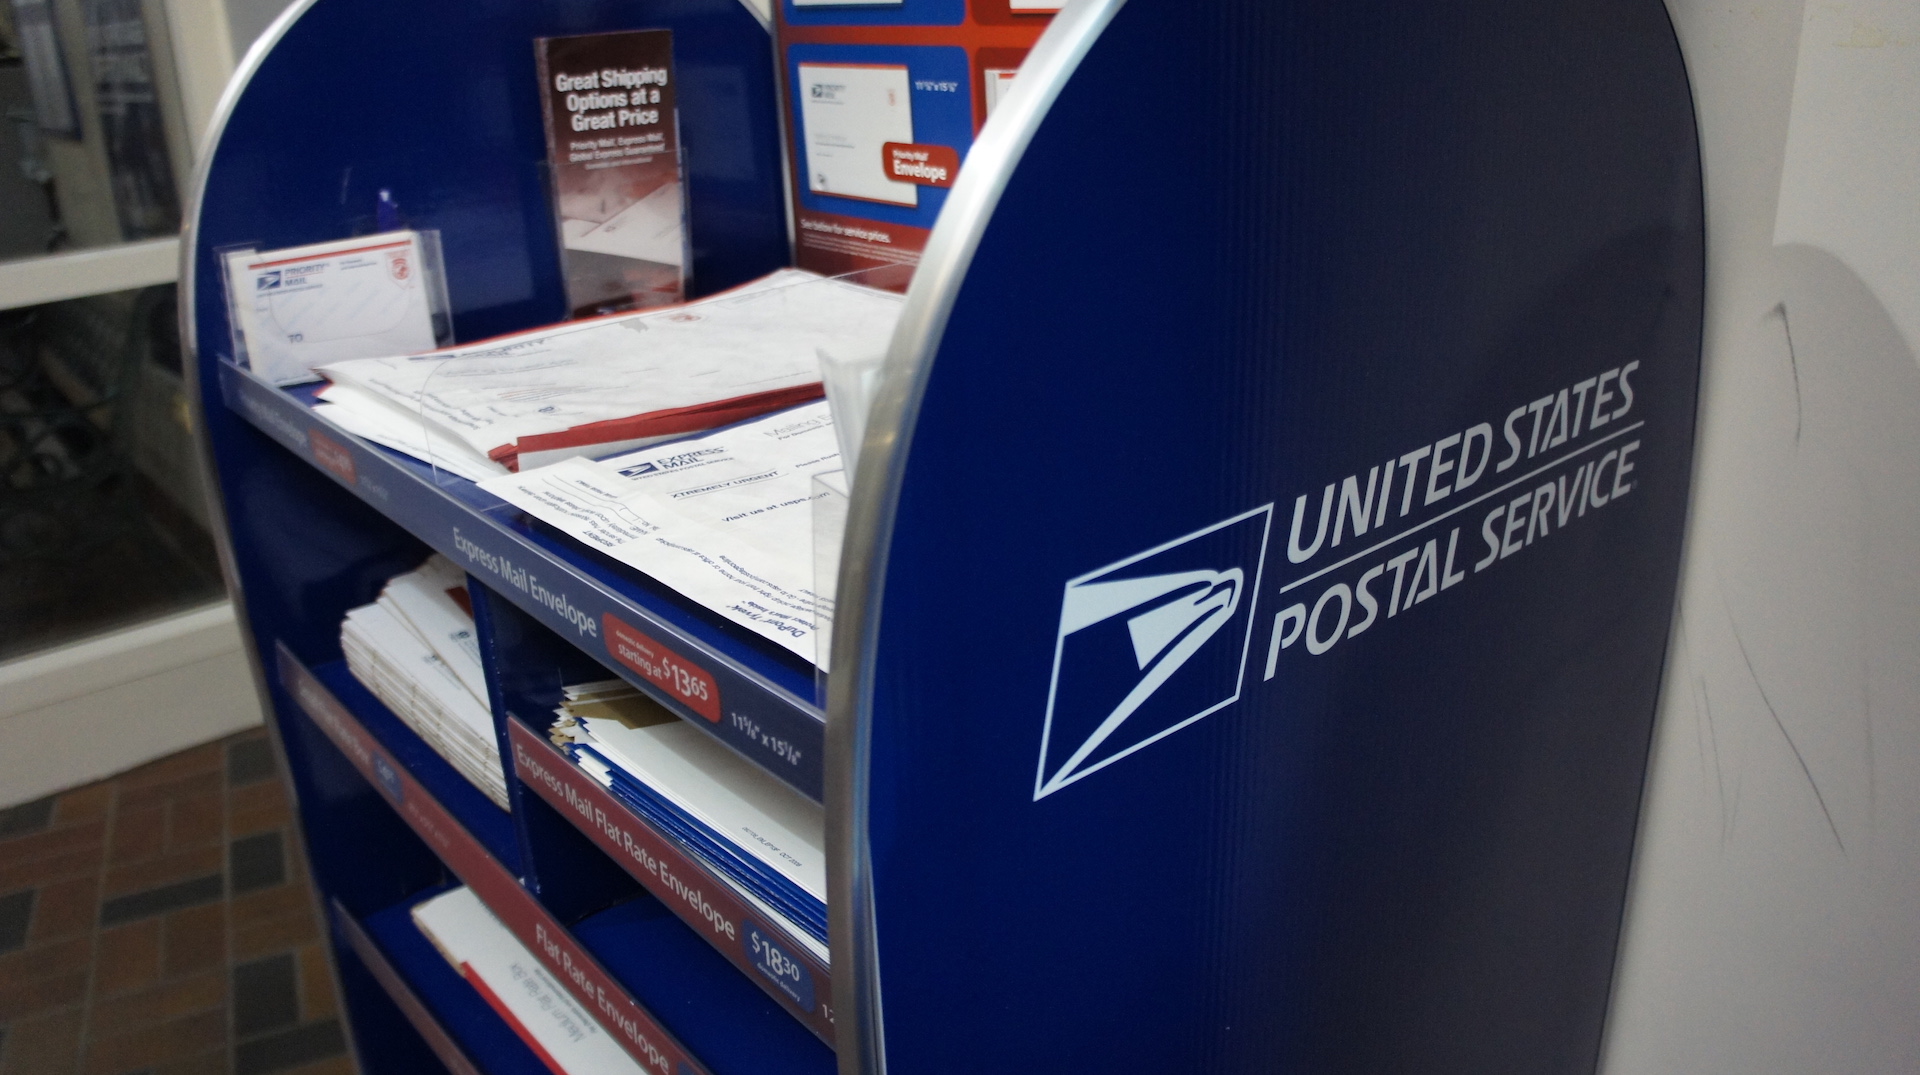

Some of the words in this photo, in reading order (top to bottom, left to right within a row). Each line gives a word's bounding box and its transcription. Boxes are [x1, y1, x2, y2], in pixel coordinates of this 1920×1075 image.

[556, 71, 600, 92] Great
[601, 67, 668, 89] Shipping
[566, 92, 628, 114] Options
[631, 88, 647, 105] at
[650, 89, 660, 103] a
[571, 111, 616, 132] Great
[618, 109, 659, 127] Price
[893, 159, 947, 183] Envelope
[801, 218, 813, 230] See
[813, 221, 833, 233] below
[833, 223, 843, 235] for
[844, 227, 868, 240] service
[285, 262, 326, 276] PRIORITY
[285, 276, 308, 287] MAIL
[288, 333, 303, 343] TO
[657, 447, 725, 465] EXPRESS
[663, 456, 702, 470] MAIL
[1287, 421, 1494, 564] UNITED
[1495, 360, 1640, 473] STATES
[733, 470, 779, 485] URGENT
[721, 512, 749, 523] Visit
[749, 508, 765, 516] us
[780, 492, 831, 507] usps.com
[1263, 527, 1465, 682] POSTAL
[1475, 439, 1641, 573] SERVICE
[453, 526, 502, 580] Express
[500, 558, 529, 595] Mail
[531, 578, 597, 638] Envelope
[766, 617, 807, 638] DuPont
[618, 643, 652, 676] starting
[652, 666, 663, 680] at
[761, 733, 769, 747] x
[516, 743, 564, 798] Express
[565, 783, 594, 823] Mail
[596, 807, 622, 844] Flat
[624, 831, 658, 873] Rate
[660, 860, 735, 942] Envelope
[535, 922, 562, 959] Flat
[562, 951, 595, 1000] Rate
[596, 985, 670, 1075] Envelope
